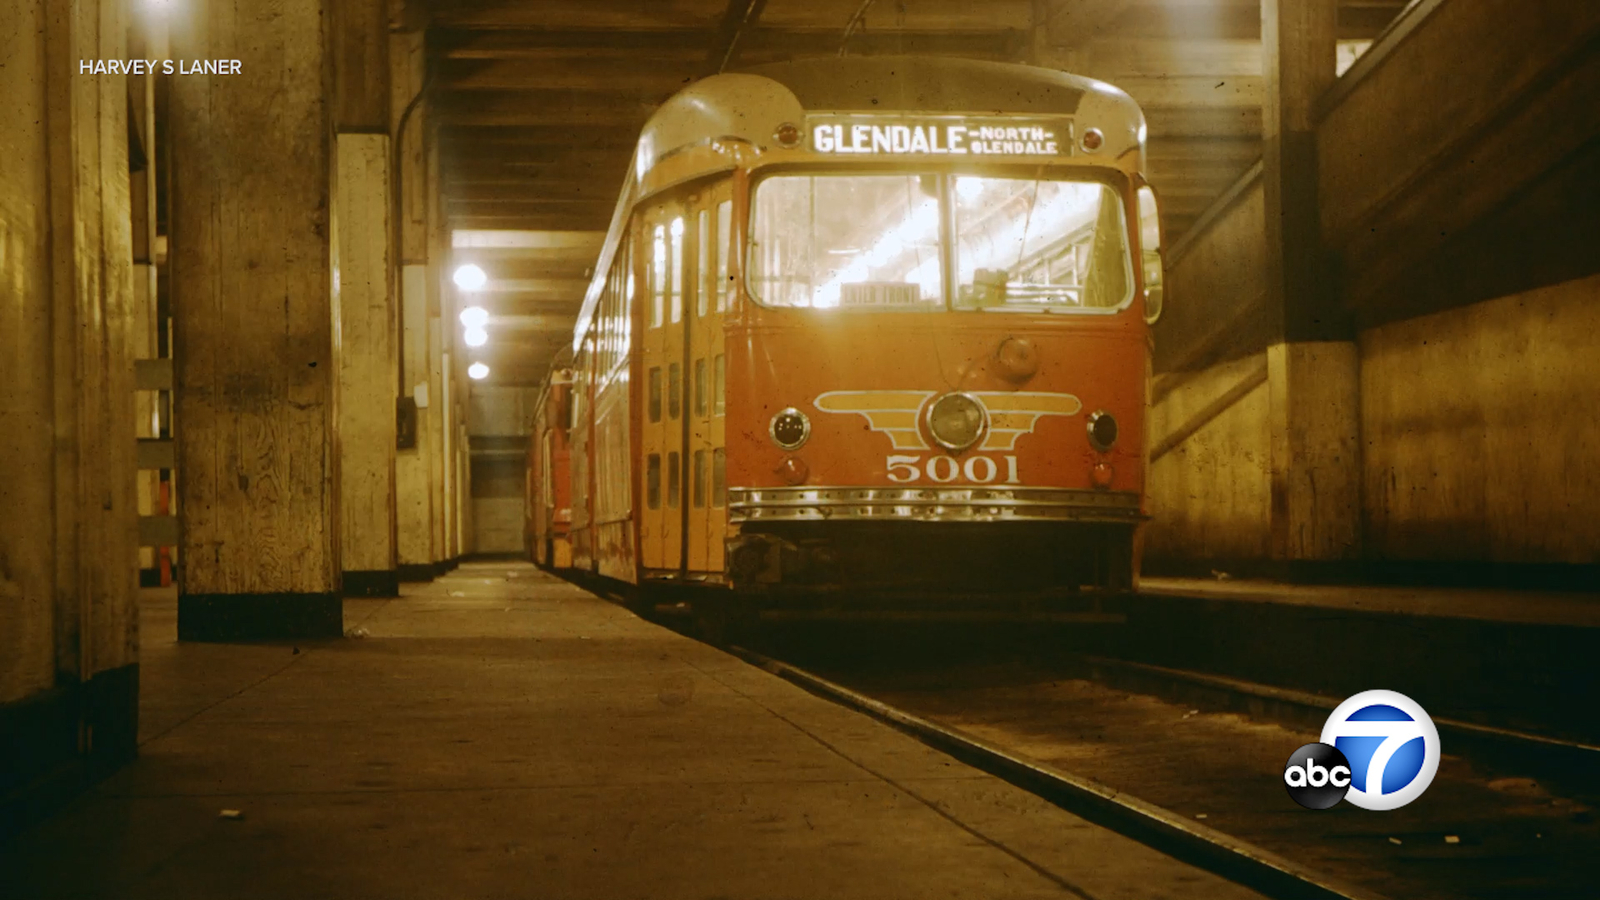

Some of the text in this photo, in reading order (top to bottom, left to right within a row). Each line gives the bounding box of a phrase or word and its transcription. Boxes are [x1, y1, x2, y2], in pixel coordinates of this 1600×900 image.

[813, 124, 967, 154] GLENDALE
[970, 141, 1058, 155] GLENDALE
[886, 454, 1021, 483] 5001
